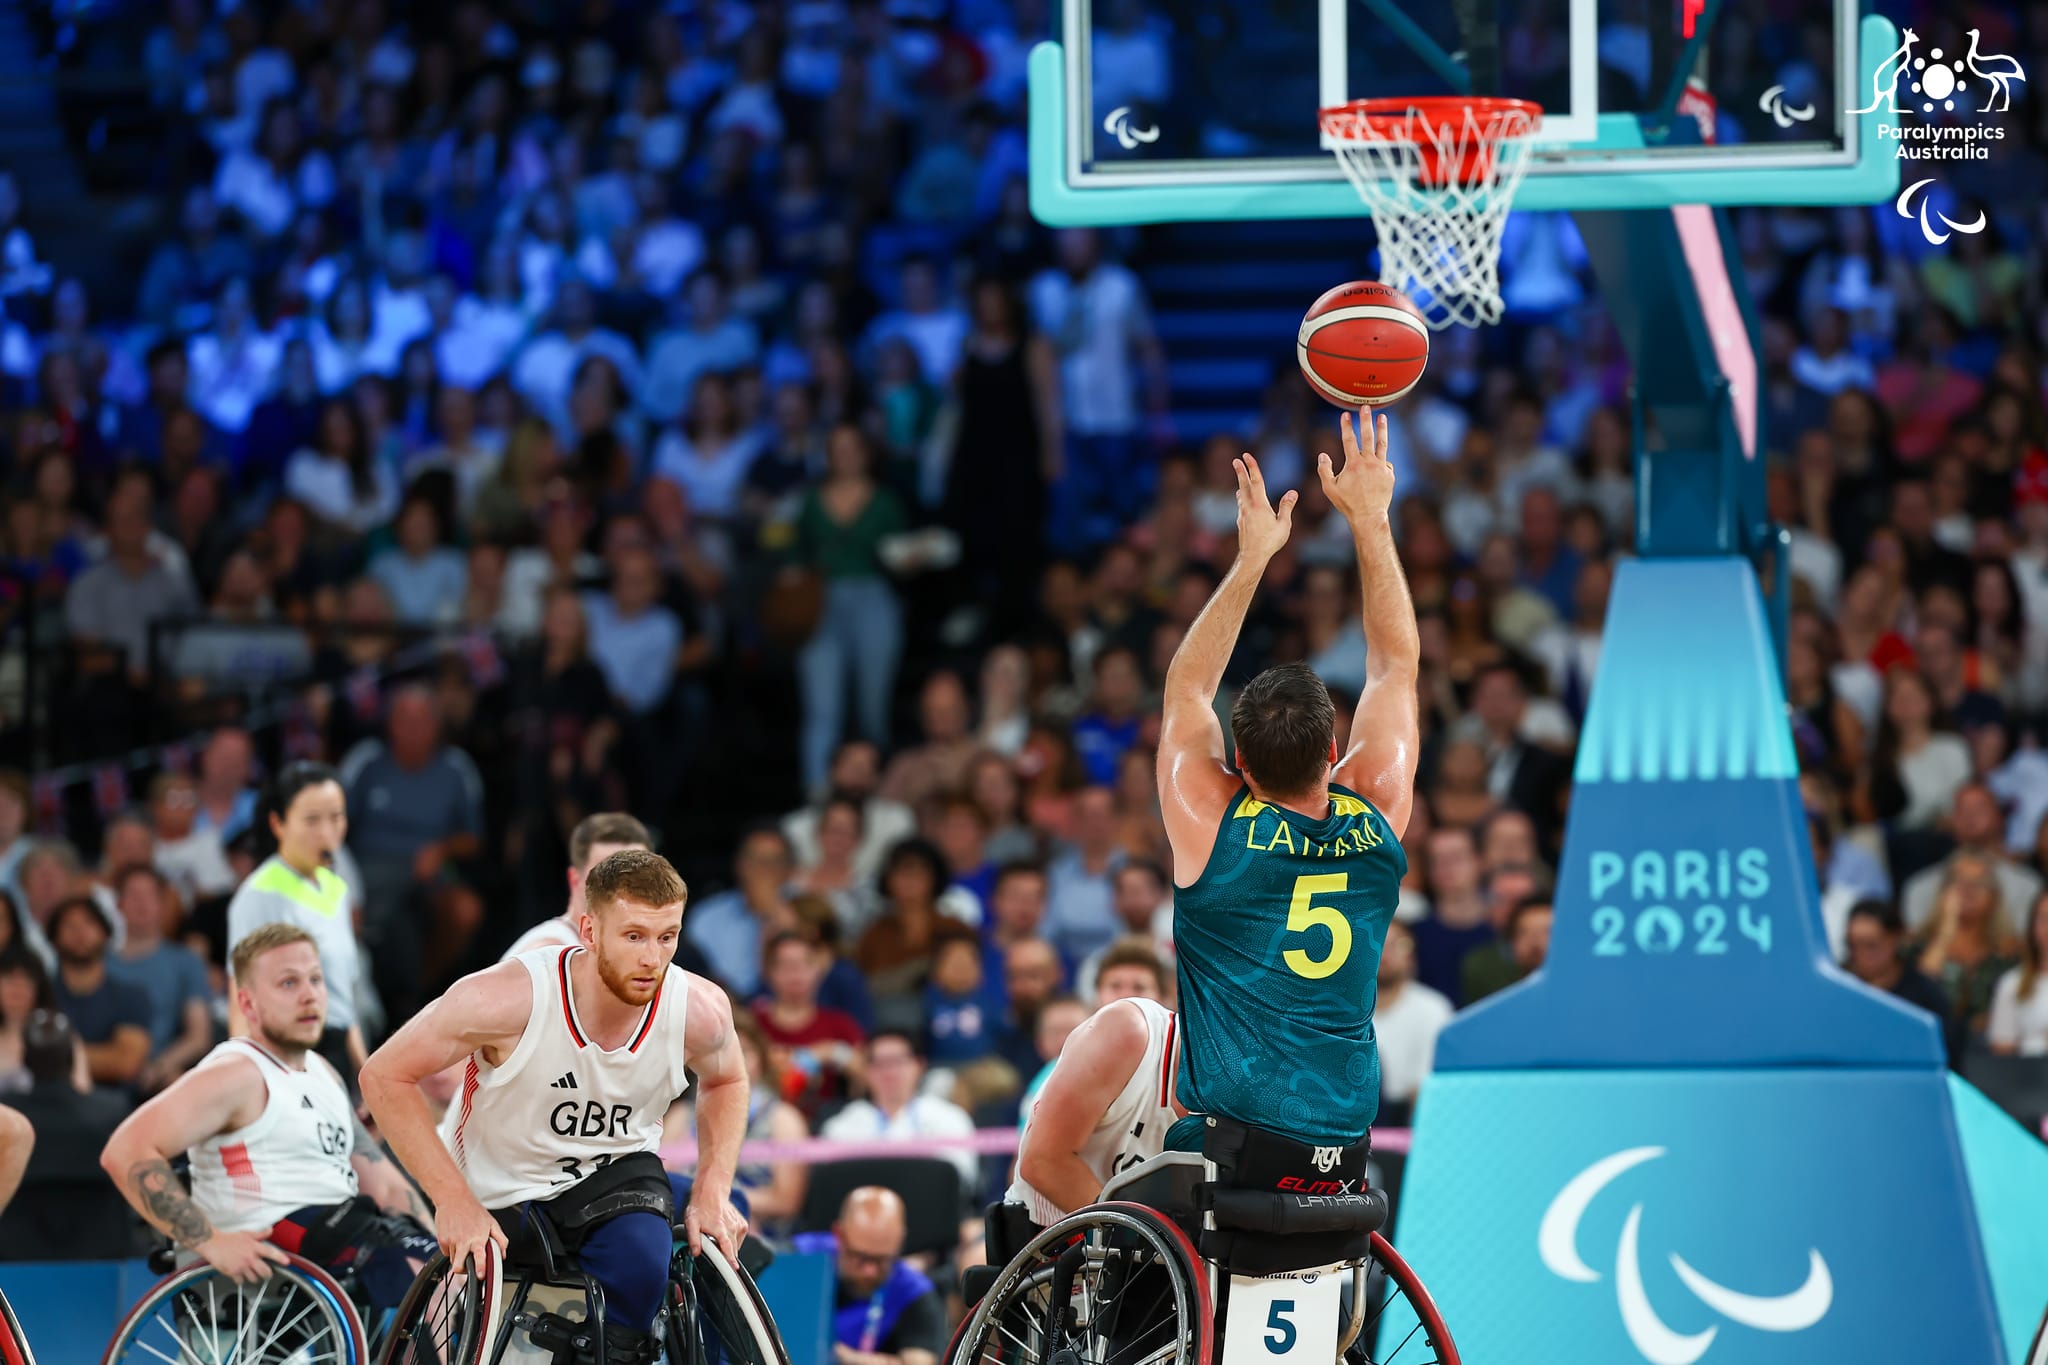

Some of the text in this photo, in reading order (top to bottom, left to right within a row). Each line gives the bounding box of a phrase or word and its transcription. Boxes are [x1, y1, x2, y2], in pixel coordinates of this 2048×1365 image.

[1589, 848, 1770, 900] PARIS
[1282, 872, 1353, 979] 5
[1591, 904, 1772, 956] 2024
[550, 1101, 632, 1137] GBR
[1296, 1195, 1374, 1208] LATHAM
[1263, 1299, 1297, 1355] 5
